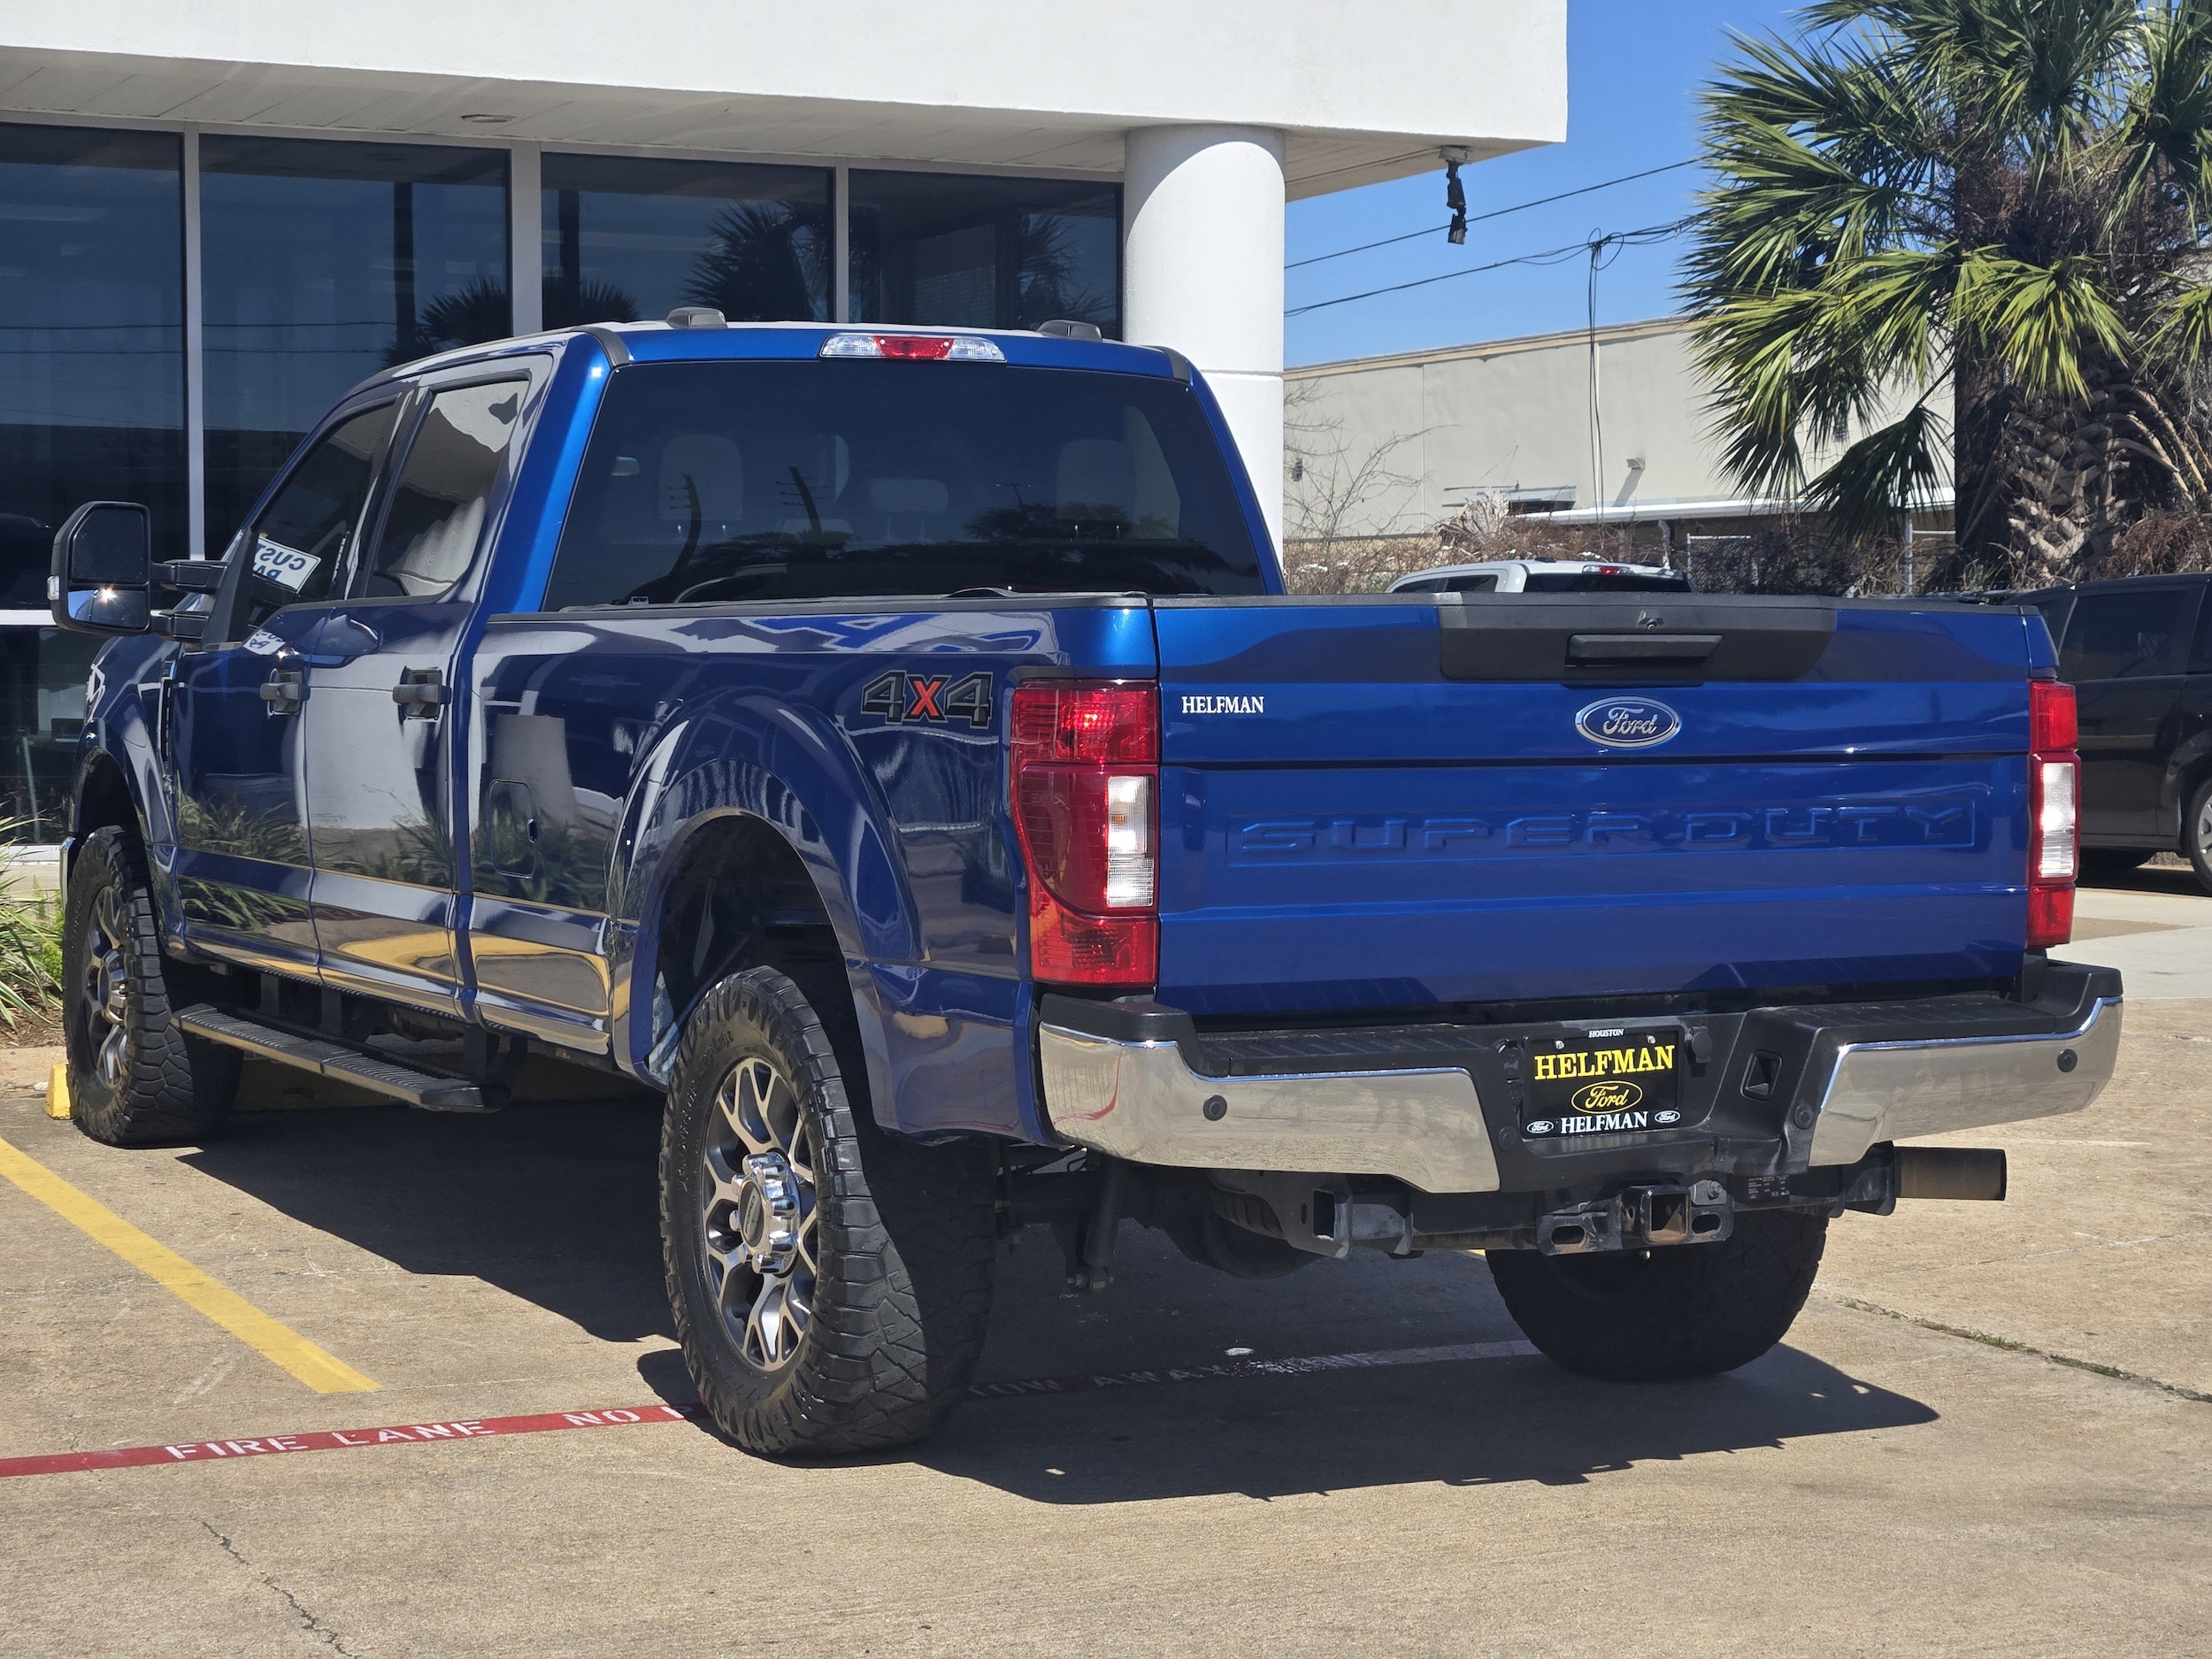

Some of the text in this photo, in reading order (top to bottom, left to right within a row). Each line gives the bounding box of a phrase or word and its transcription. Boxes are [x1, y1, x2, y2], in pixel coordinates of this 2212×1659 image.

[1181, 696, 1264, 713] HELFMAN
[1602, 707, 1659, 735] Ford
[1240, 806, 1963, 852] SUPER DUTY
[1588, 1028, 1624, 1039] HOUSTON
[1534, 1045, 1675, 1080] HELFMAN
[1560, 1111, 1648, 1134] HELFMAN
[165, 1436, 309, 1459] FIRE
[331, 1421, 495, 1445] LANE
[562, 1409, 641, 1426] NO
